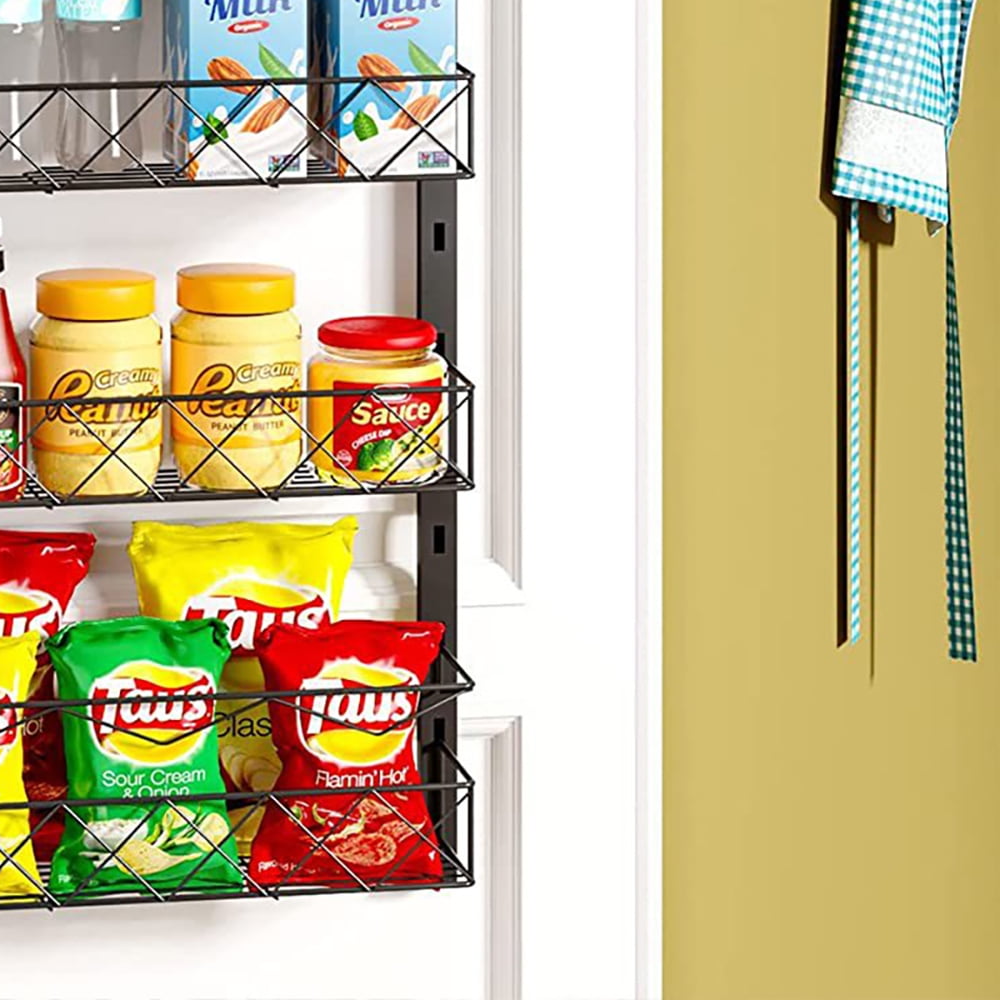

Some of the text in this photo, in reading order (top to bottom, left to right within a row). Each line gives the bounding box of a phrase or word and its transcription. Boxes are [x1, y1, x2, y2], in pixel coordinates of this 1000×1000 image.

[351, 401, 431, 426] Sauce
[102, 769, 206, 787] Sour Cream
